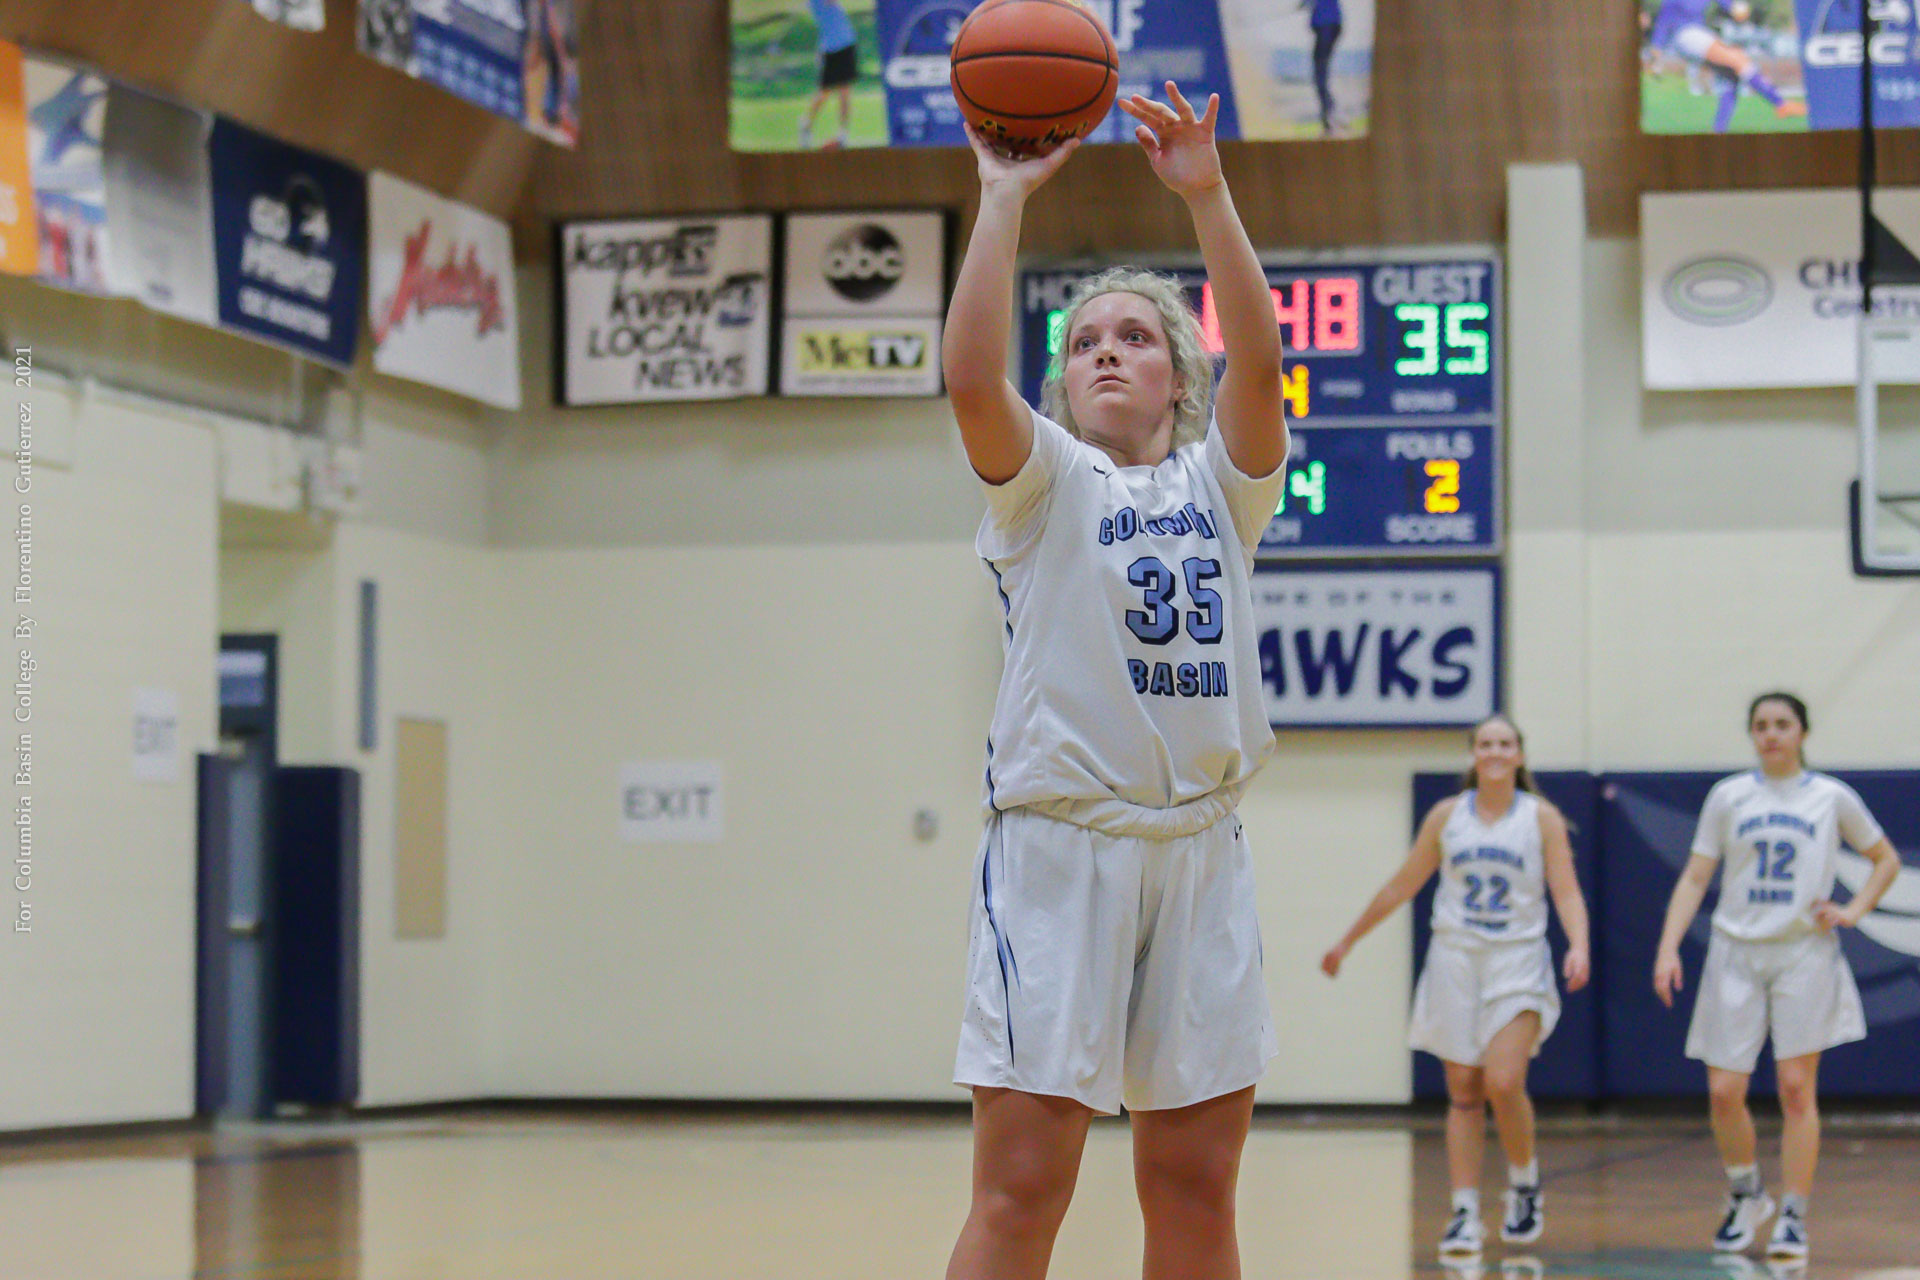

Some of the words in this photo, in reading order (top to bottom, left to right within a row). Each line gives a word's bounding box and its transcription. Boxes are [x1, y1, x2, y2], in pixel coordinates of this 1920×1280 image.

[1373, 266, 1485, 305] GUEST
[586, 323, 712, 358] LOCAL
[1395, 302, 1489, 375] 35
[636, 354, 745, 389] NEWS
[1273, 460, 1326, 515] 4
[1424, 459, 1460, 513] 2
[1125, 556, 1223, 646] 35
[1127, 659, 1228, 698] BASIN
[1259, 622, 1475, 697] AWKS
[622, 785, 714, 820] EXIT
[1754, 841, 1795, 879] 12
[1464, 874, 1510, 911] 22
